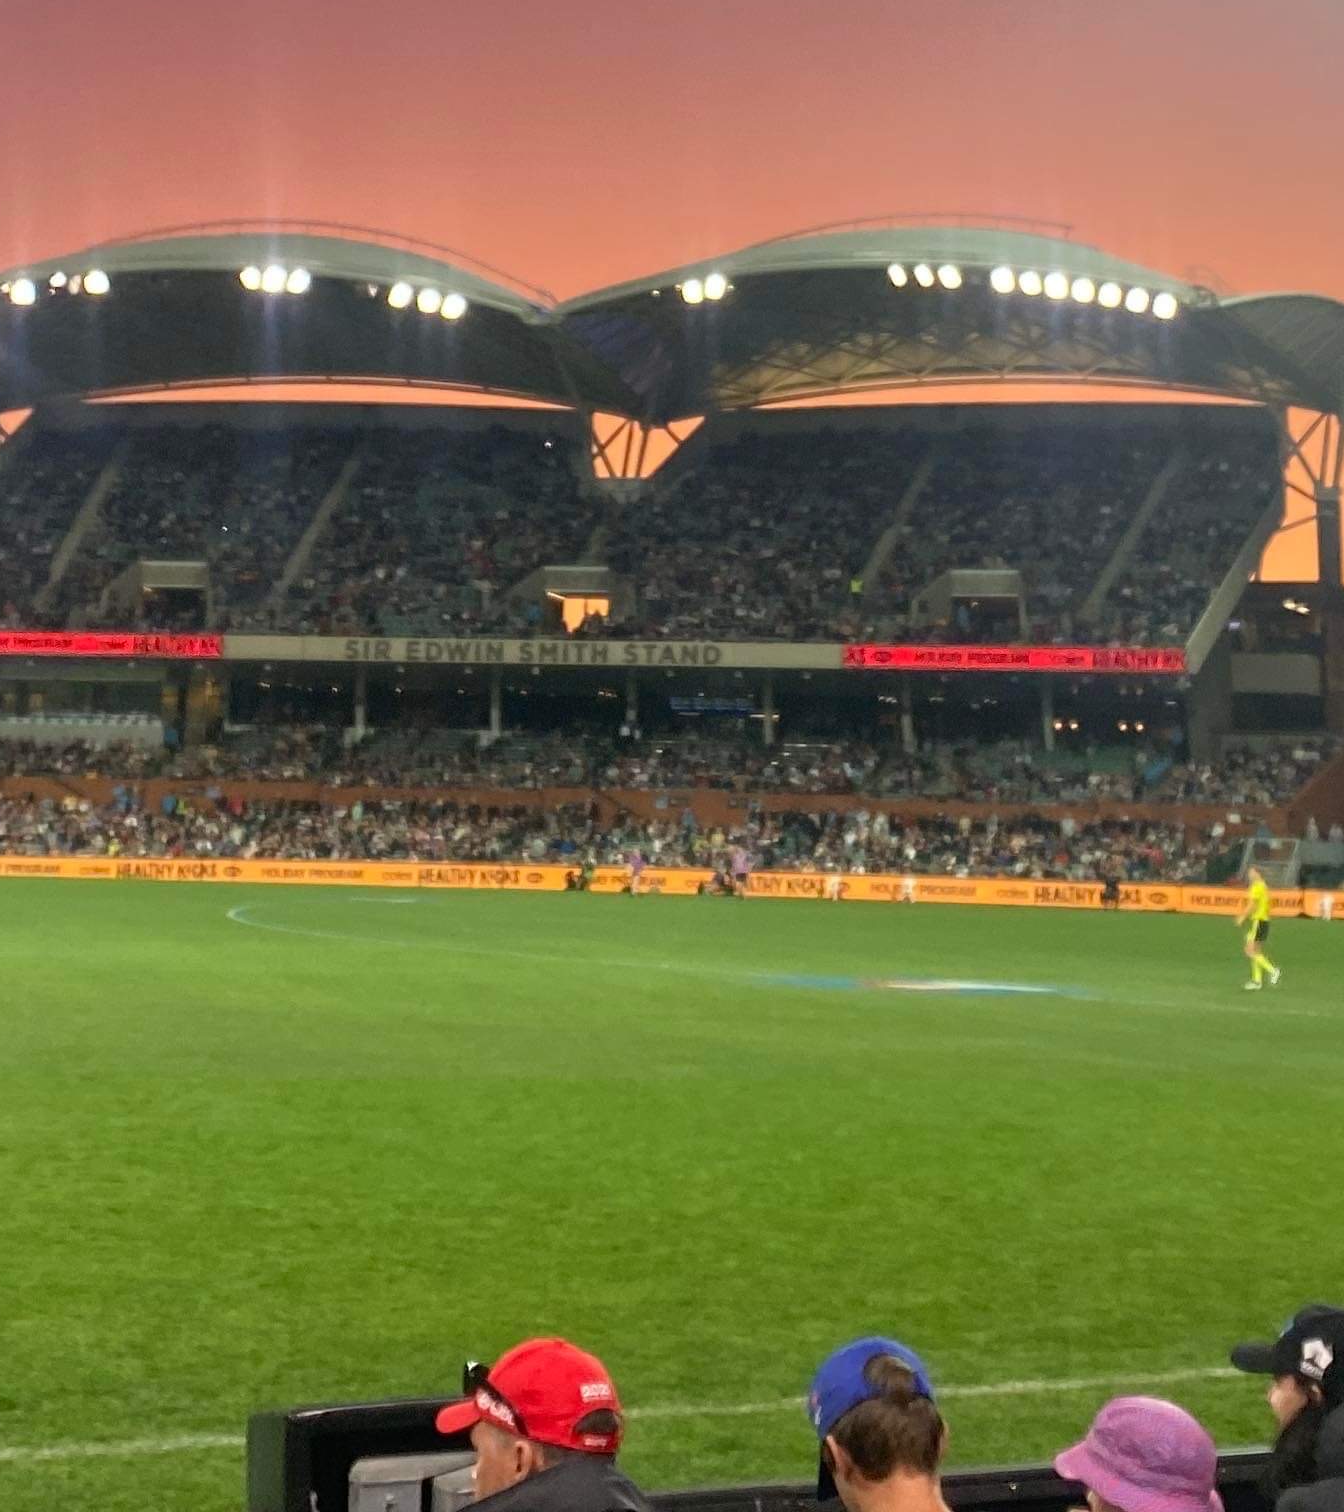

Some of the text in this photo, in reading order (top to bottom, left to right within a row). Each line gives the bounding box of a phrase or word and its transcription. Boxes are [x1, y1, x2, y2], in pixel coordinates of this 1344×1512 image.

[345, 640, 722, 666] SIR EDWIN SMITH STAND
[116, 862, 174, 878] HEALTHY
[308, 868, 364, 879] PROGRAM
[418, 868, 475, 884] HEALTHY
[1034, 887, 1096, 904] HEALTHY
